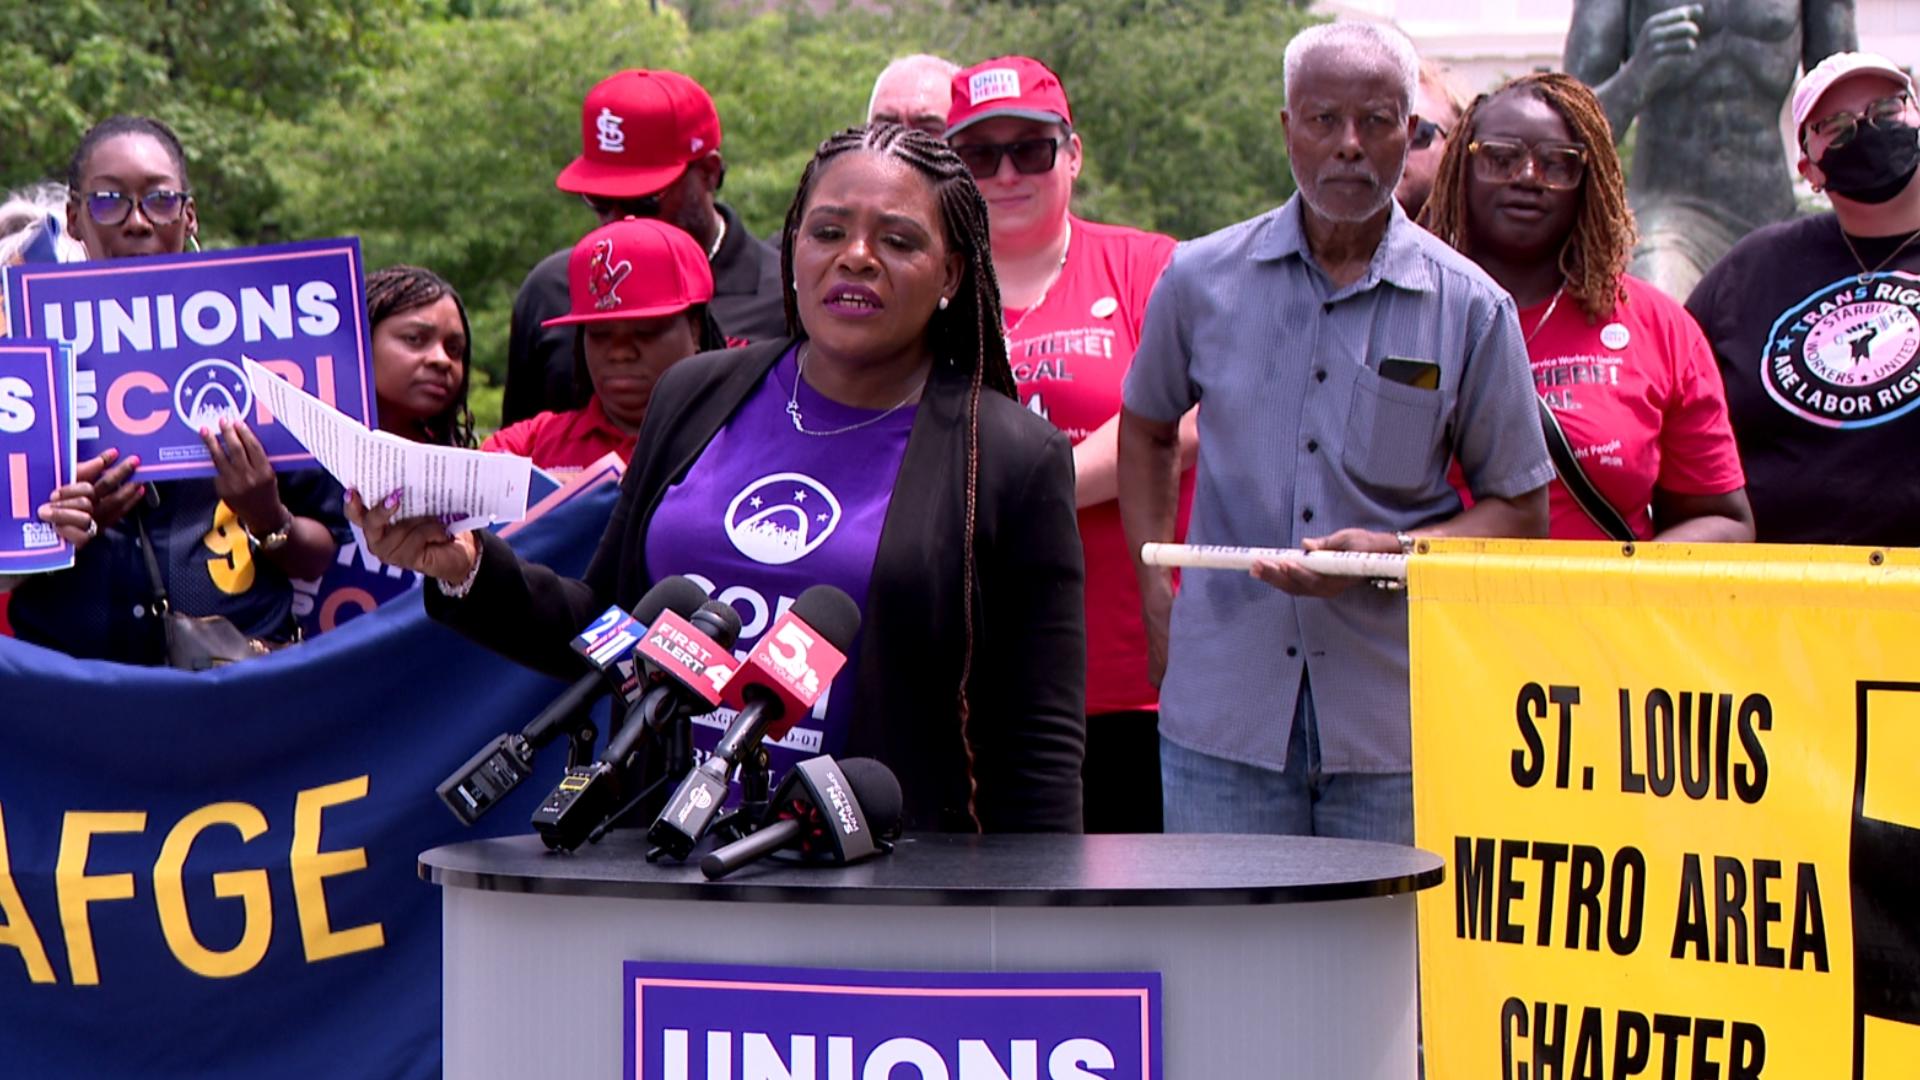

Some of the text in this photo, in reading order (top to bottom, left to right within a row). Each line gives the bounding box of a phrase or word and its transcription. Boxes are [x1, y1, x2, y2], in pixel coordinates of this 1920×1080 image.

[44, 280, 341, 356] UNIONS
[1790, 286, 1868, 332] TRANS
[1529, 358, 1557, 371] ervice
[1807, 341, 1855, 384] WORKERS
[1873, 338, 1916, 378] UNITED
[1774, 355, 1800, 390] ARE
[1795, 383, 1872, 414] LABOR
[650, 634, 704, 673] ALERT
[704, 664, 734, 693] 4
[658, 622, 713, 662] FIRST
[768, 620, 815, 680] 5
[759, 652, 773, 667] ON
[773, 660, 796, 685] YOUR
[784, 729, 818, 747] O-01
[1511, 681, 1773, 805] ST. LOUIS
[826, 771, 860, 832] SPECTRUM
[826, 786, 853, 834] NEWS
[1454, 836, 1831, 973] METRO AREA
[662, 1028, 1116, 1080] UNIONS
[1500, 996, 1768, 1080] CHAPTER
